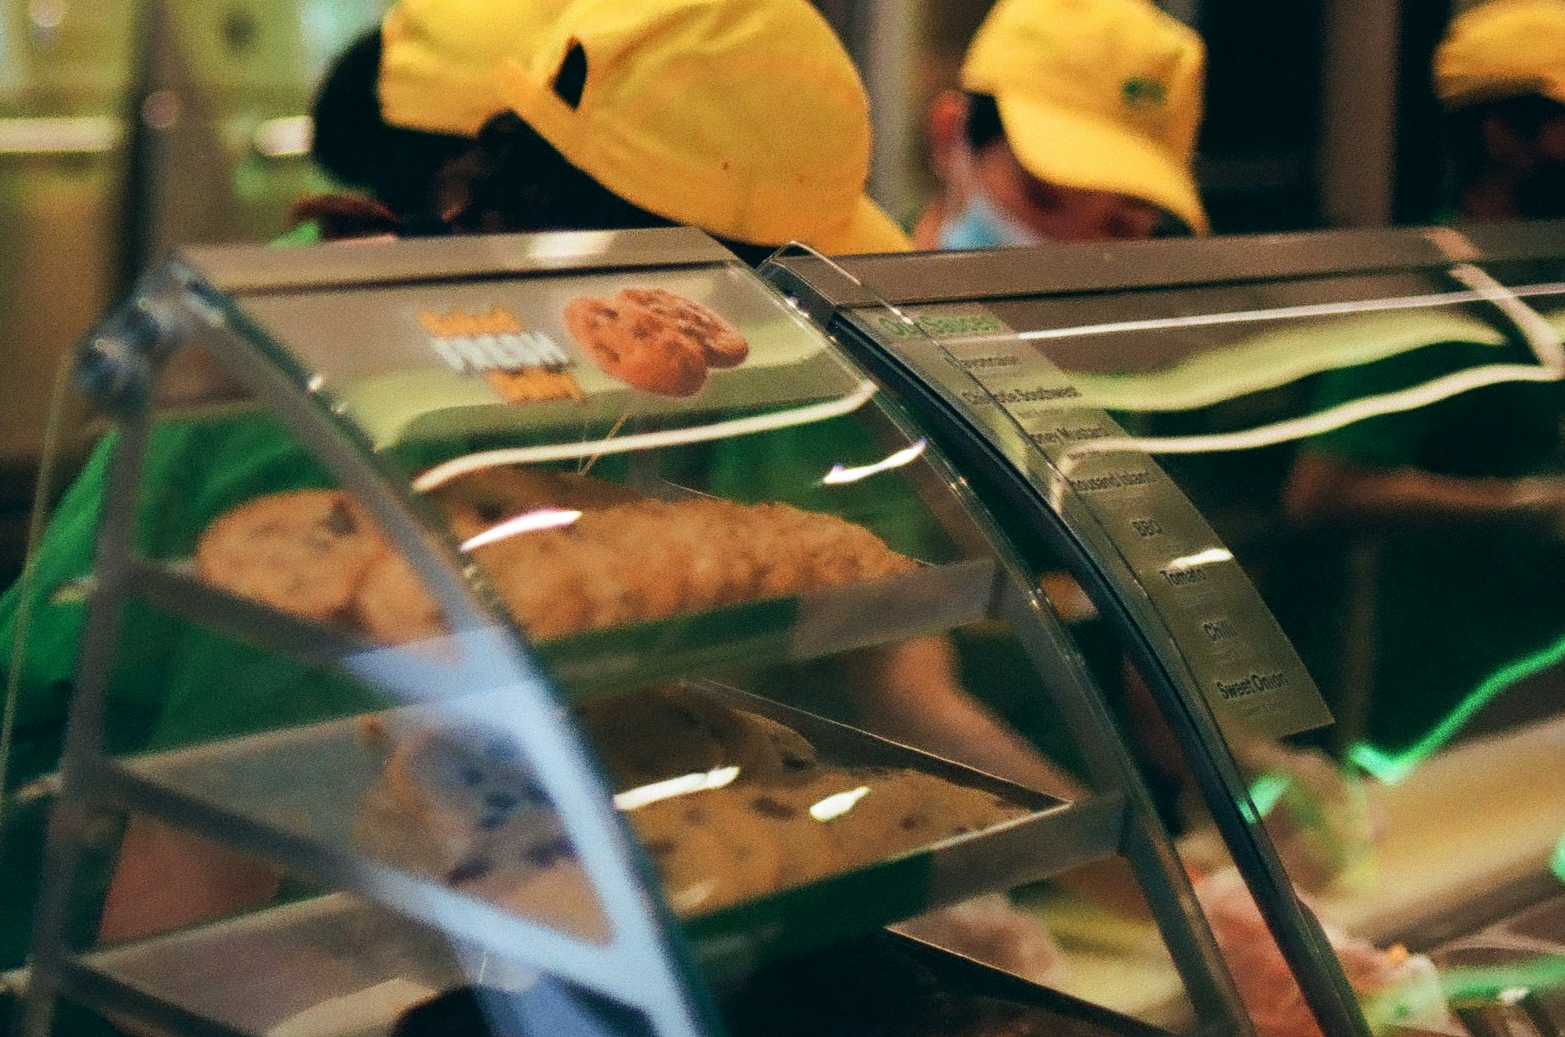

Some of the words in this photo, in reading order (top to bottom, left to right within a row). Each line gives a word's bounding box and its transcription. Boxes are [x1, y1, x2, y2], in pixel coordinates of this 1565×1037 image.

[1065, 472, 1122, 493] housand
[1132, 519, 1164, 538] BBQ
[1159, 568, 1206, 586] Tomato
[1216, 678, 1255, 700] Sweet
[1250, 673, 1289, 692] Onion
